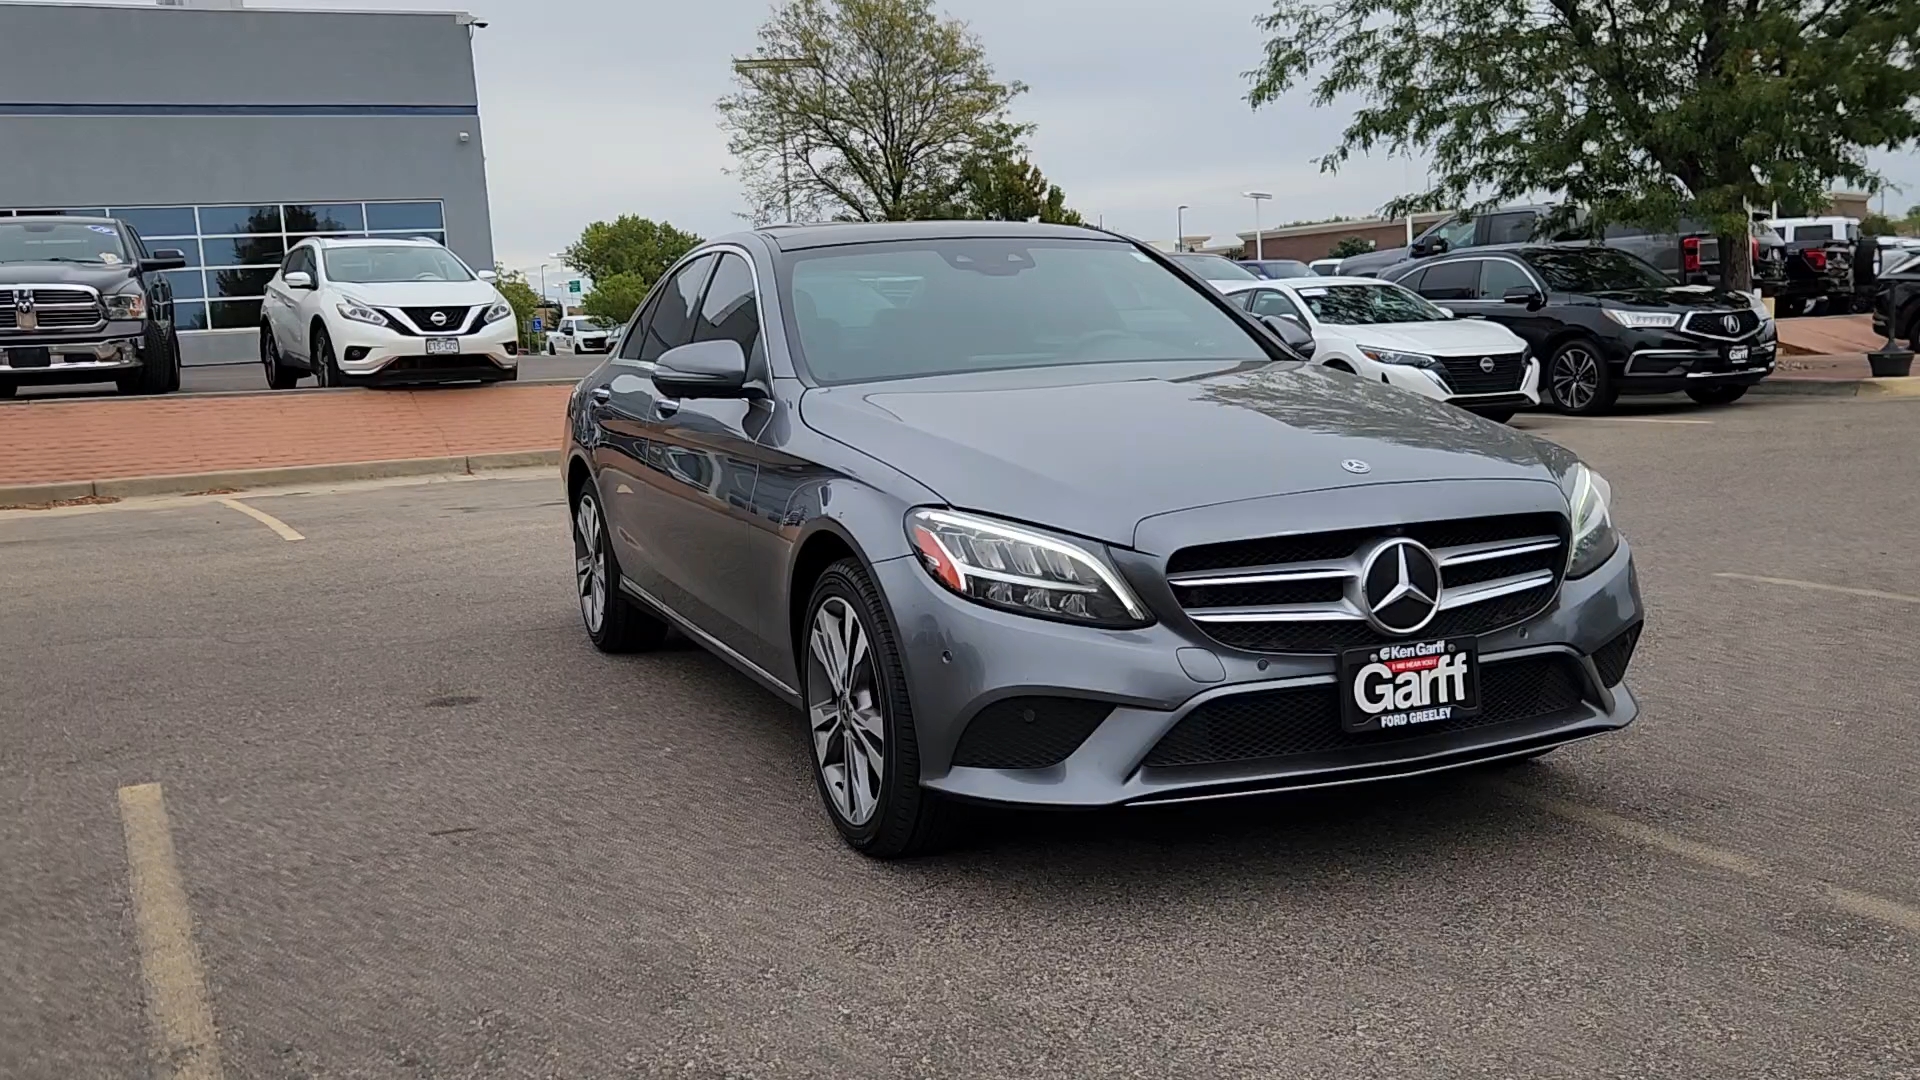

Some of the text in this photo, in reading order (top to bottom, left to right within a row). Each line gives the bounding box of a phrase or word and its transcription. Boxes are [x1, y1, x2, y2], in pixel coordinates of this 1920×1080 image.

[1391, 640, 1445, 659] Ken Garff
[1354, 652, 1468, 713] Garff
[1381, 707, 1451, 728] FORD GREELEY
